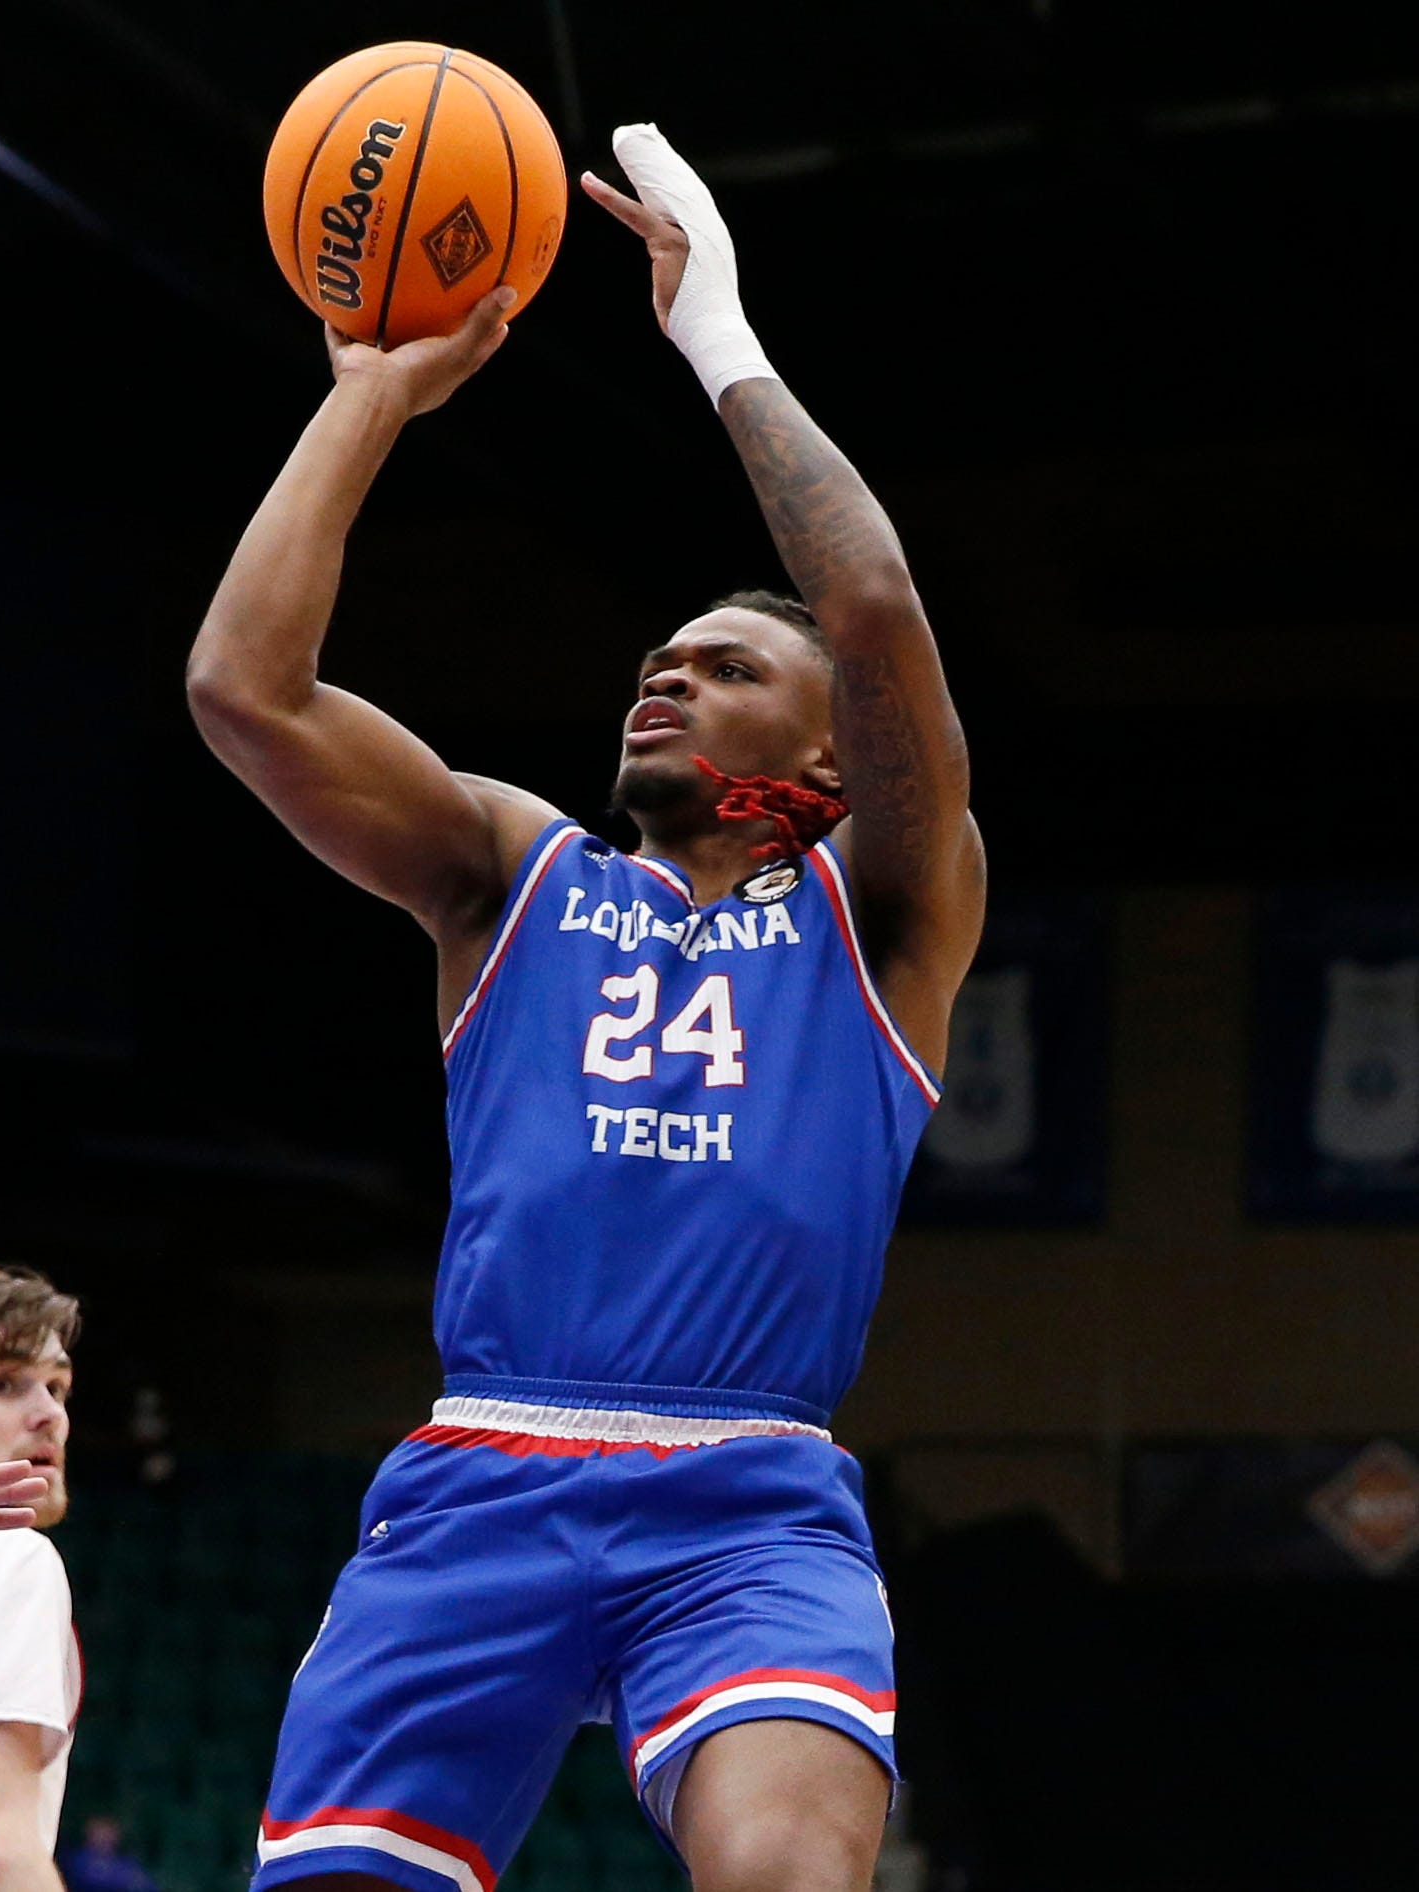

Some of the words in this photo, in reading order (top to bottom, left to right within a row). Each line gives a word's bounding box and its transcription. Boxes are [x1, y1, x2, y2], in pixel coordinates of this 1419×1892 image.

[316, 118, 406, 310] Wilson
[582, 962, 745, 1087] 24
[586, 1103, 733, 1162] TECH
